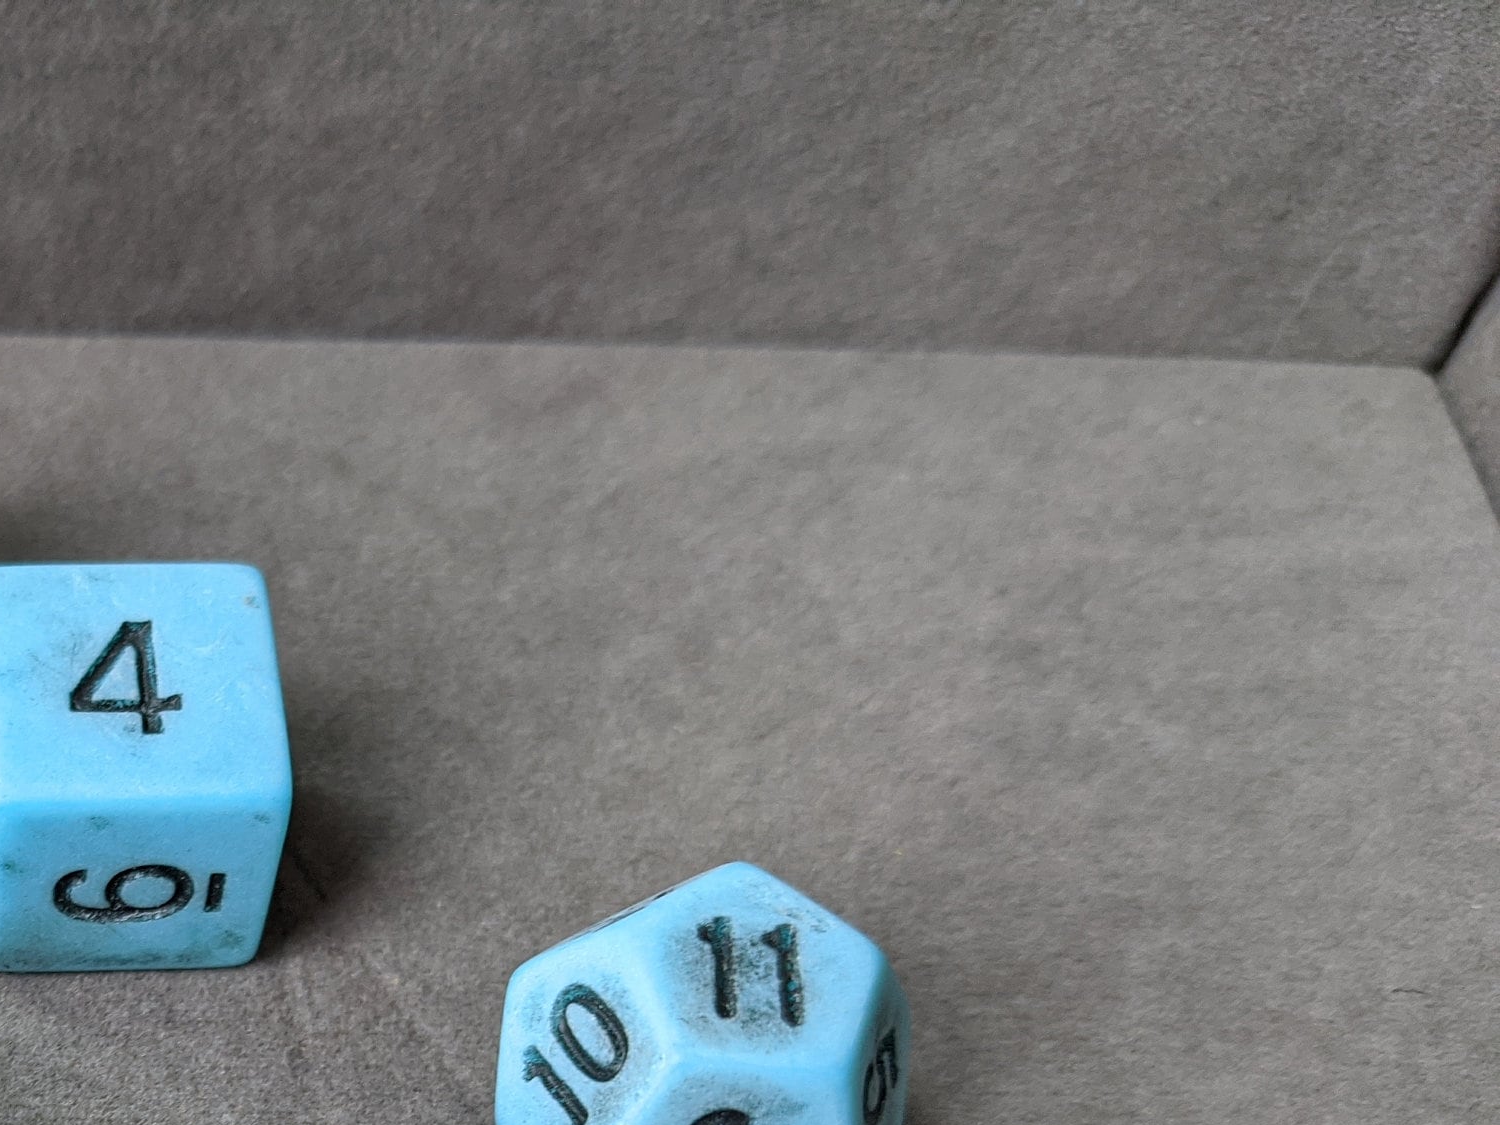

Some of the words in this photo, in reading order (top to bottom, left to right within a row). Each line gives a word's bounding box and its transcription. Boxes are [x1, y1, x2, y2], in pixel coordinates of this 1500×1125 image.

[67, 621, 183, 735] 4
[52, 864, 227, 924] 6
[697, 915, 806, 1028] 11
